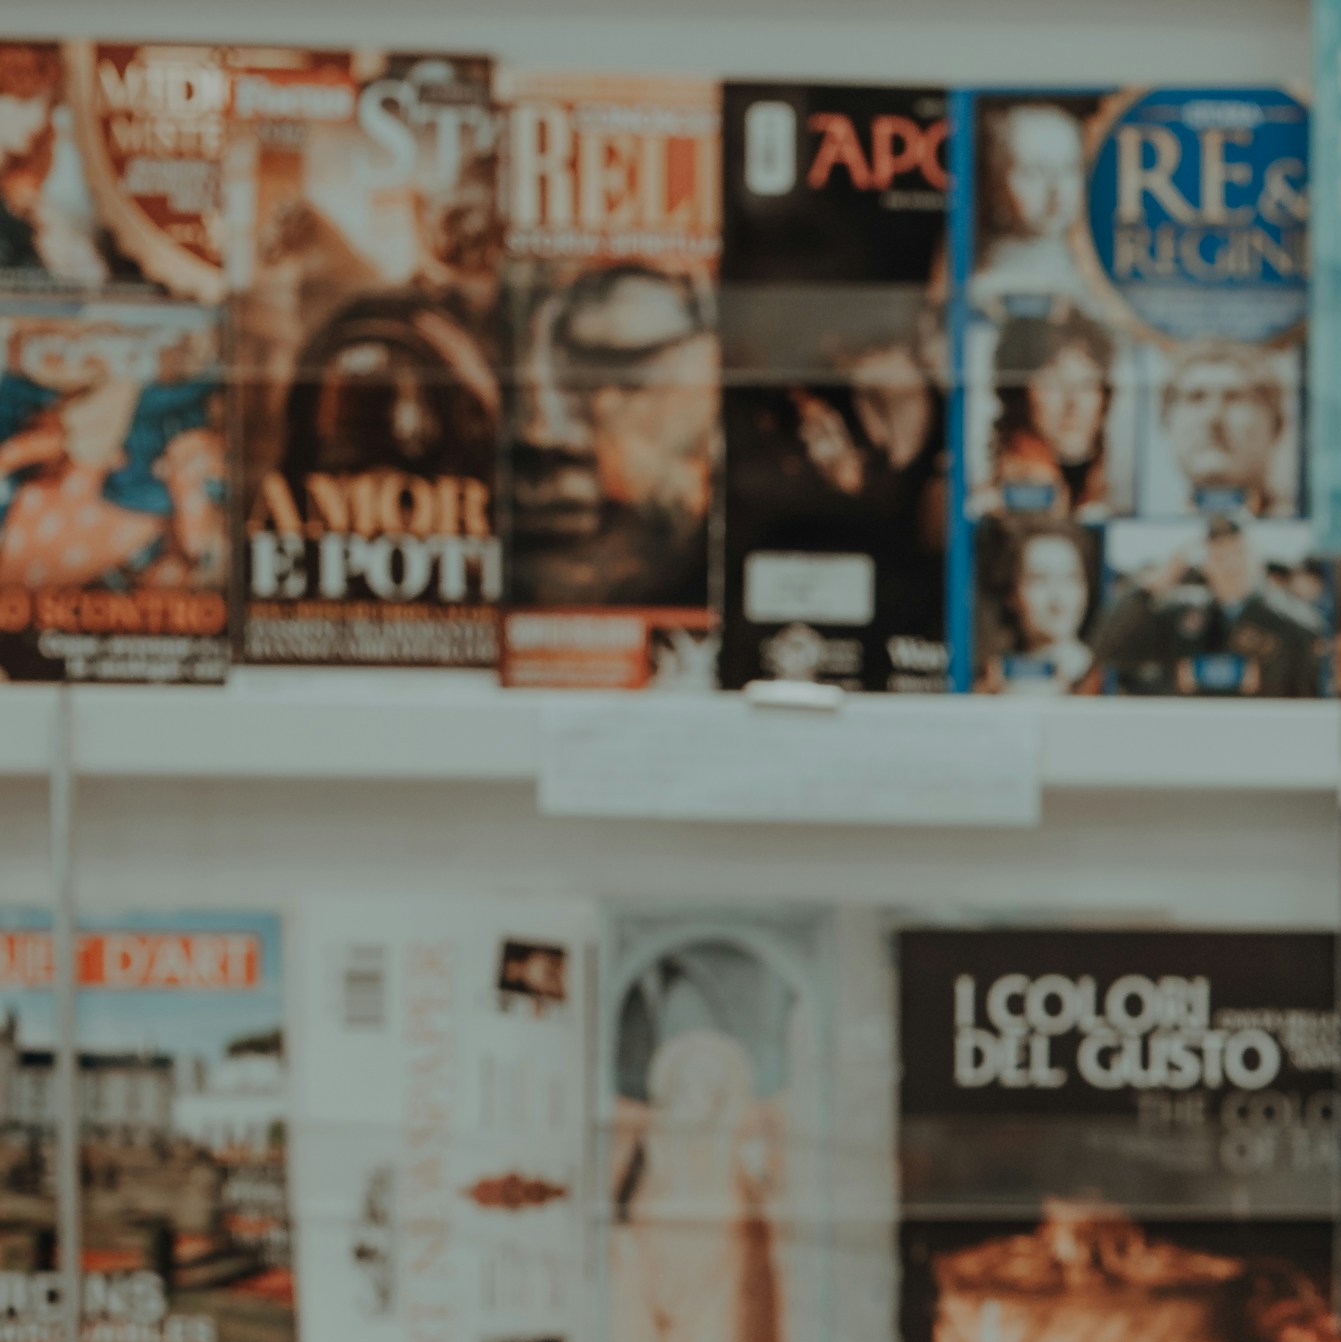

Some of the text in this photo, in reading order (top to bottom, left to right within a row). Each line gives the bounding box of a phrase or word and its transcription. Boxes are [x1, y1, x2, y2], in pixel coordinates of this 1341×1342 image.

[1116, 122, 1253, 225] RE
[1258, 157, 1308, 227] &
[104, 934, 259, 986] D'ART
[951, 972, 1211, 1035] I COLORI
[953, 1027, 1069, 1089] DEL
[1078, 1029, 1282, 1090] GUSTO
